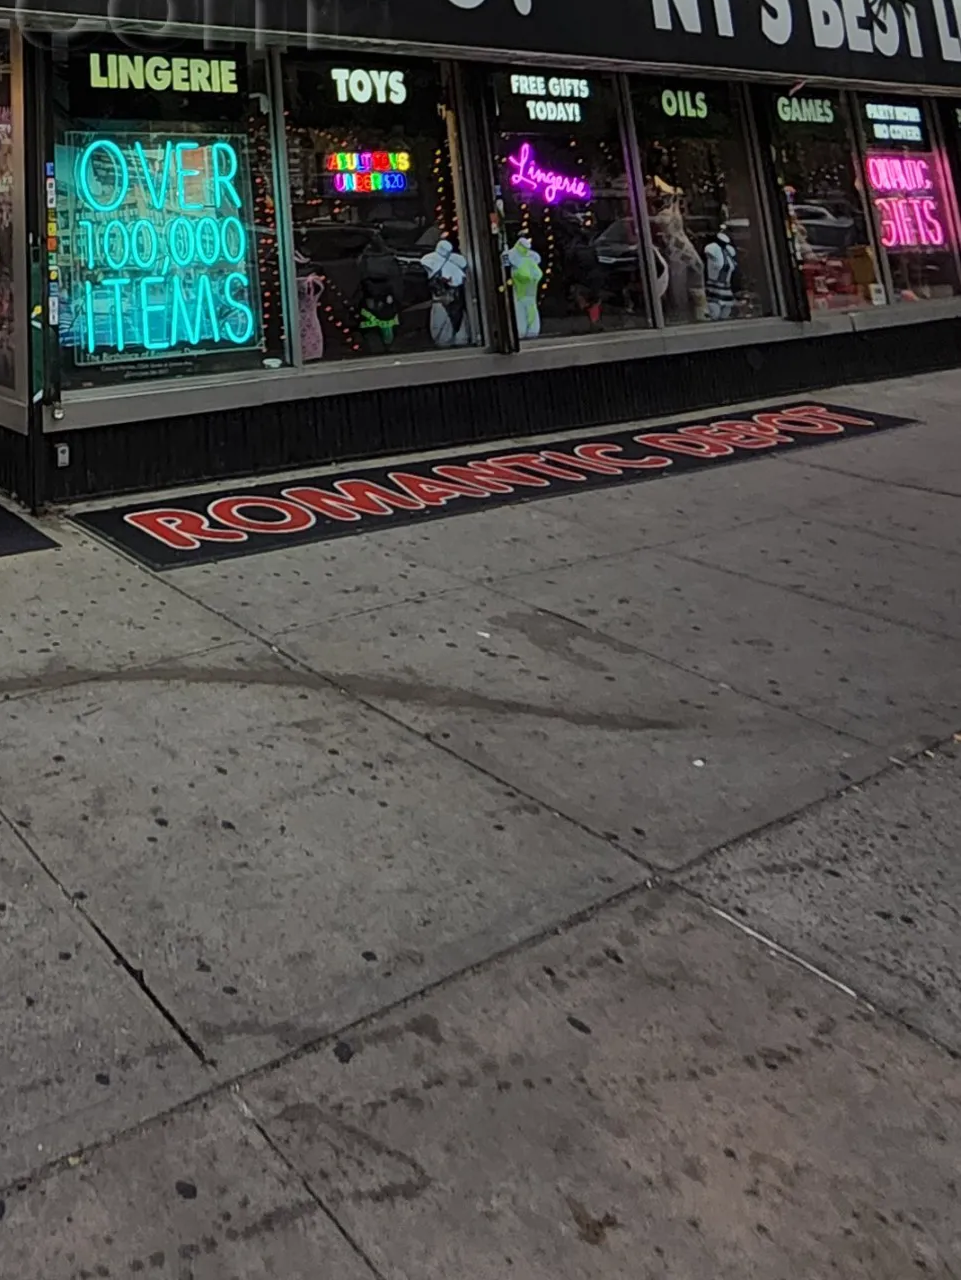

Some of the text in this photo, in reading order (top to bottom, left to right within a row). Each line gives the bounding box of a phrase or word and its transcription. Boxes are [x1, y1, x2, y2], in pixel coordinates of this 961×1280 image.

[89, 53, 238, 93] LINGERIE
[331, 69, 407, 104] TOYS
[510, 74, 590, 99] FREE GIFTS
[526, 100, 581, 123] TODAY!
[661, 89, 707, 118] OILS
[777, 97, 834, 123] GAMES
[78, 139, 243, 212] OVER
[327, 151, 410, 171] ADULT TOYS
[509, 142, 591, 204] Lingerie
[334, 172, 407, 192] UNDER $20
[79, 216, 247, 274] 100,000
[85, 272, 255, 353] ITEMS
[124, 403, 877, 551] ROMANTIC DEPOT
